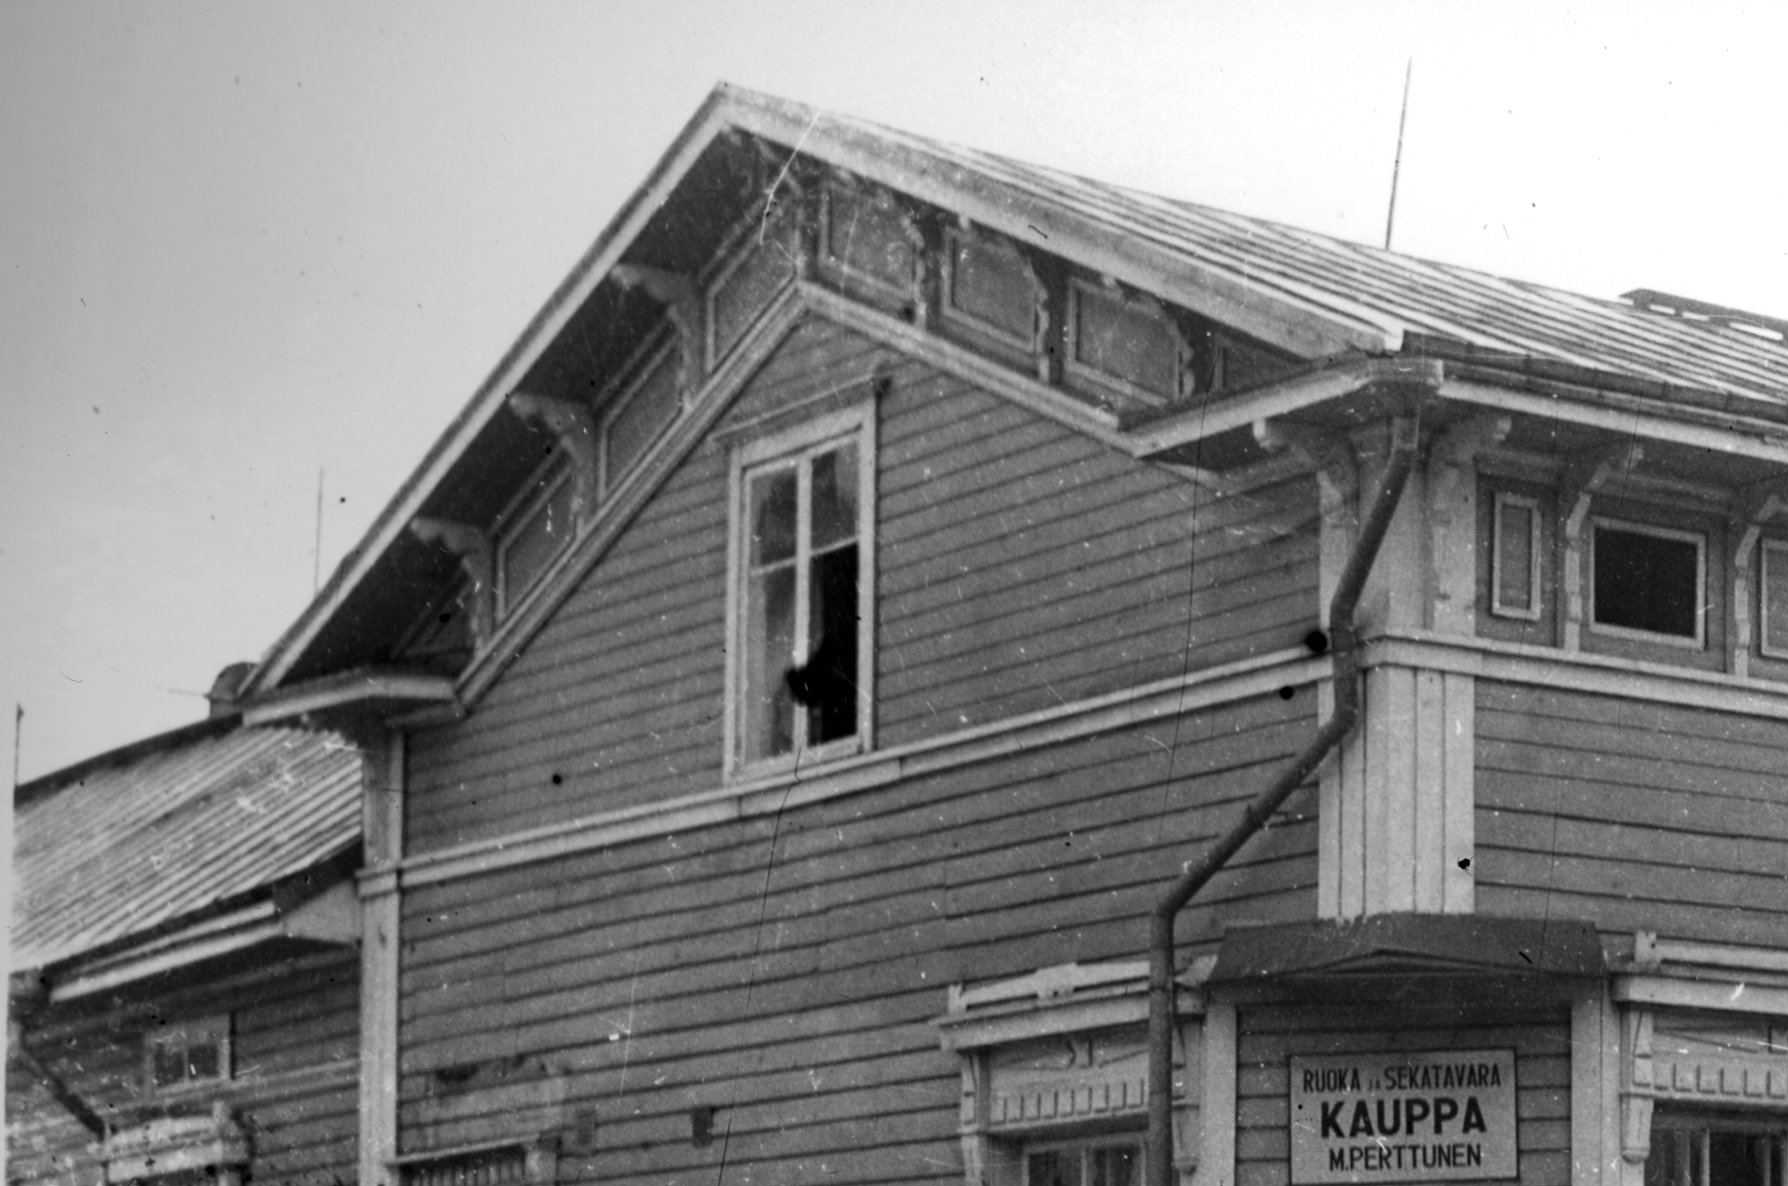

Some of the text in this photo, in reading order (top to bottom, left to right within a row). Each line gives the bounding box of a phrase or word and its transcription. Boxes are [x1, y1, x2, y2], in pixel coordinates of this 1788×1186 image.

[1303, 1068, 1361, 1093] RUOKA
[1384, 1063, 1501, 1090] SEKATAVARA
[1321, 1096, 1487, 1138] KAUPPA
